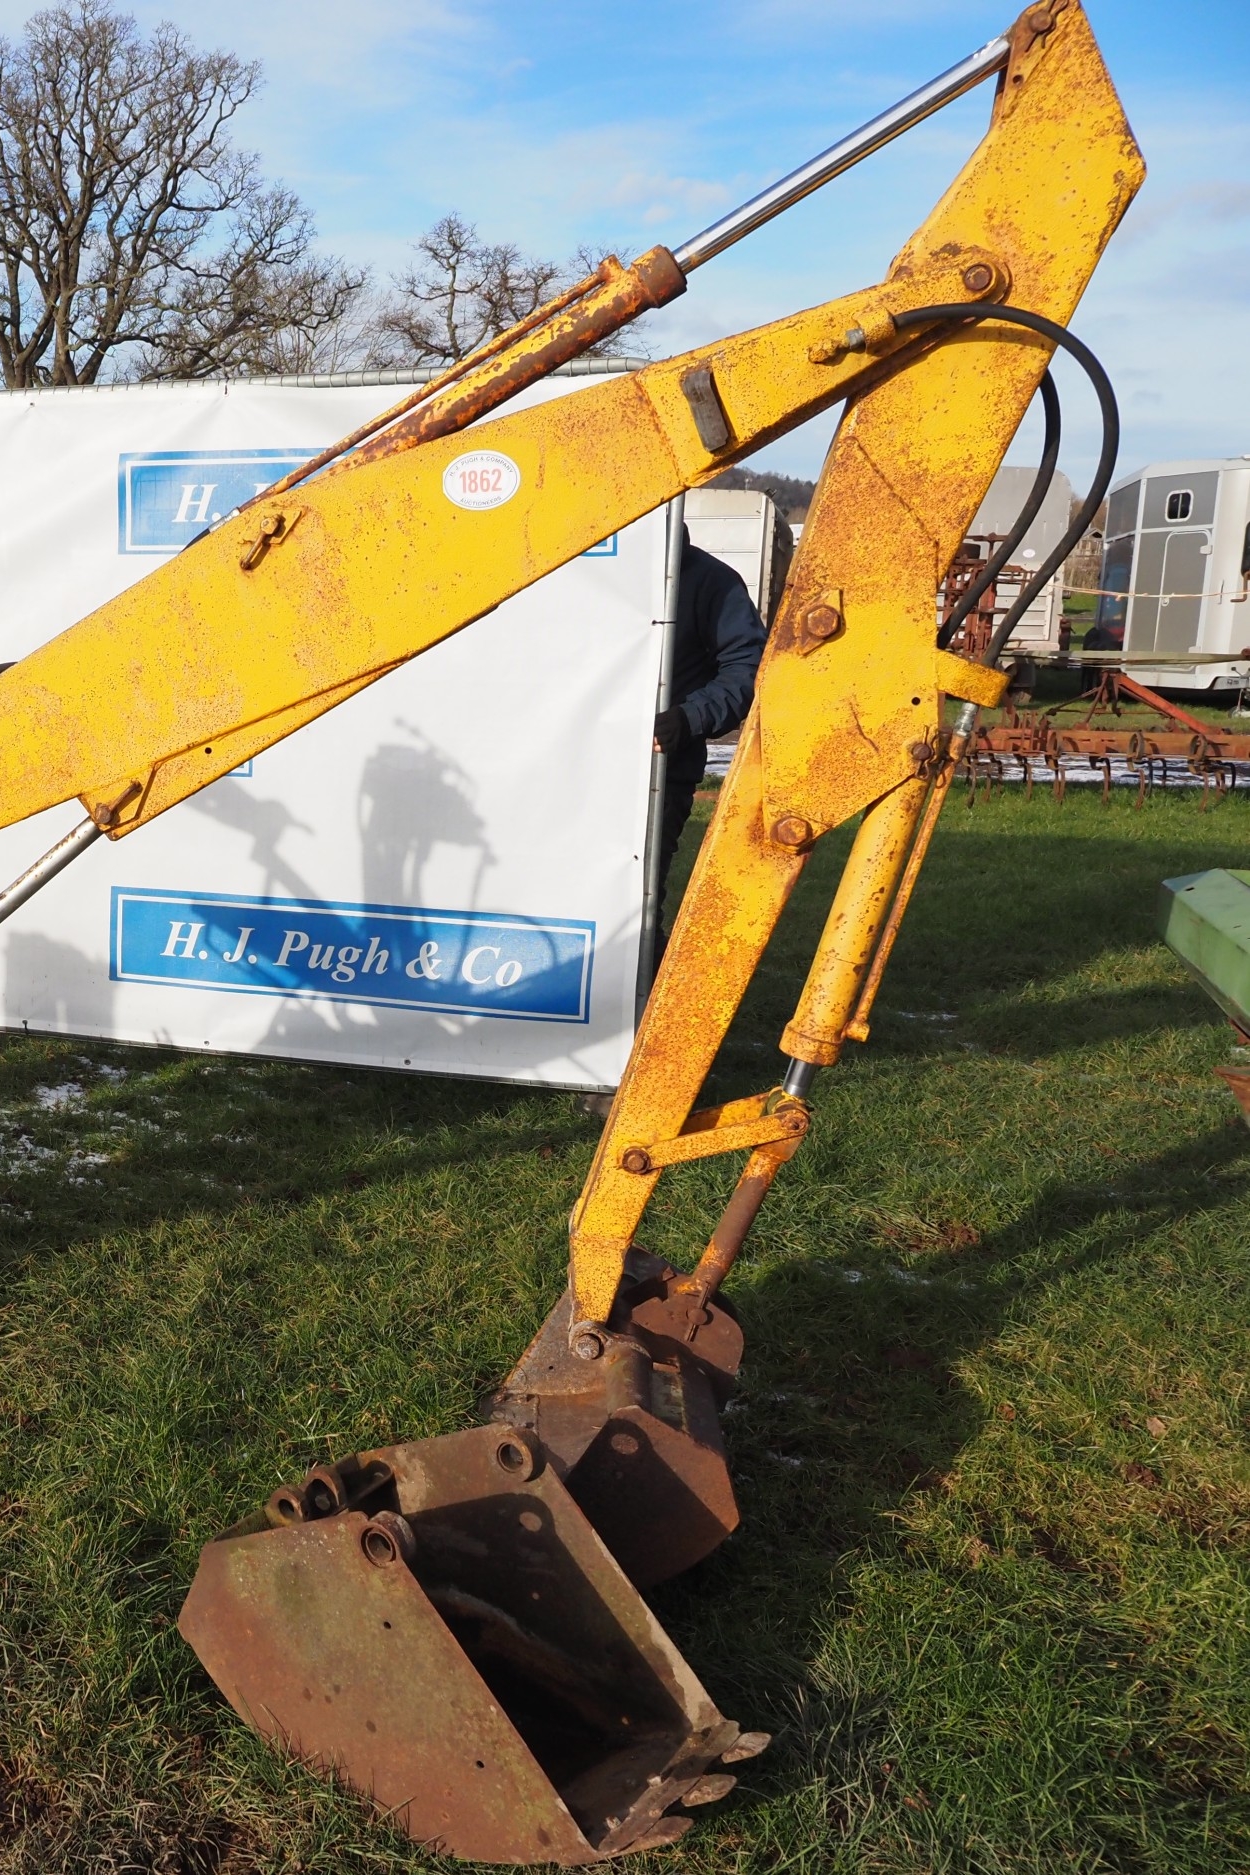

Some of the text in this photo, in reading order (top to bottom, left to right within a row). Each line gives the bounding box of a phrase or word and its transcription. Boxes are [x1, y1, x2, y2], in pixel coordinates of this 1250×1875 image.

[485, 456, 514, 473] COMPANY
[459, 468, 502, 494] 1862
[460, 496, 502, 507] AUCTIONEERS
[160, 921, 523, 987] H. J. Pugh & Co
